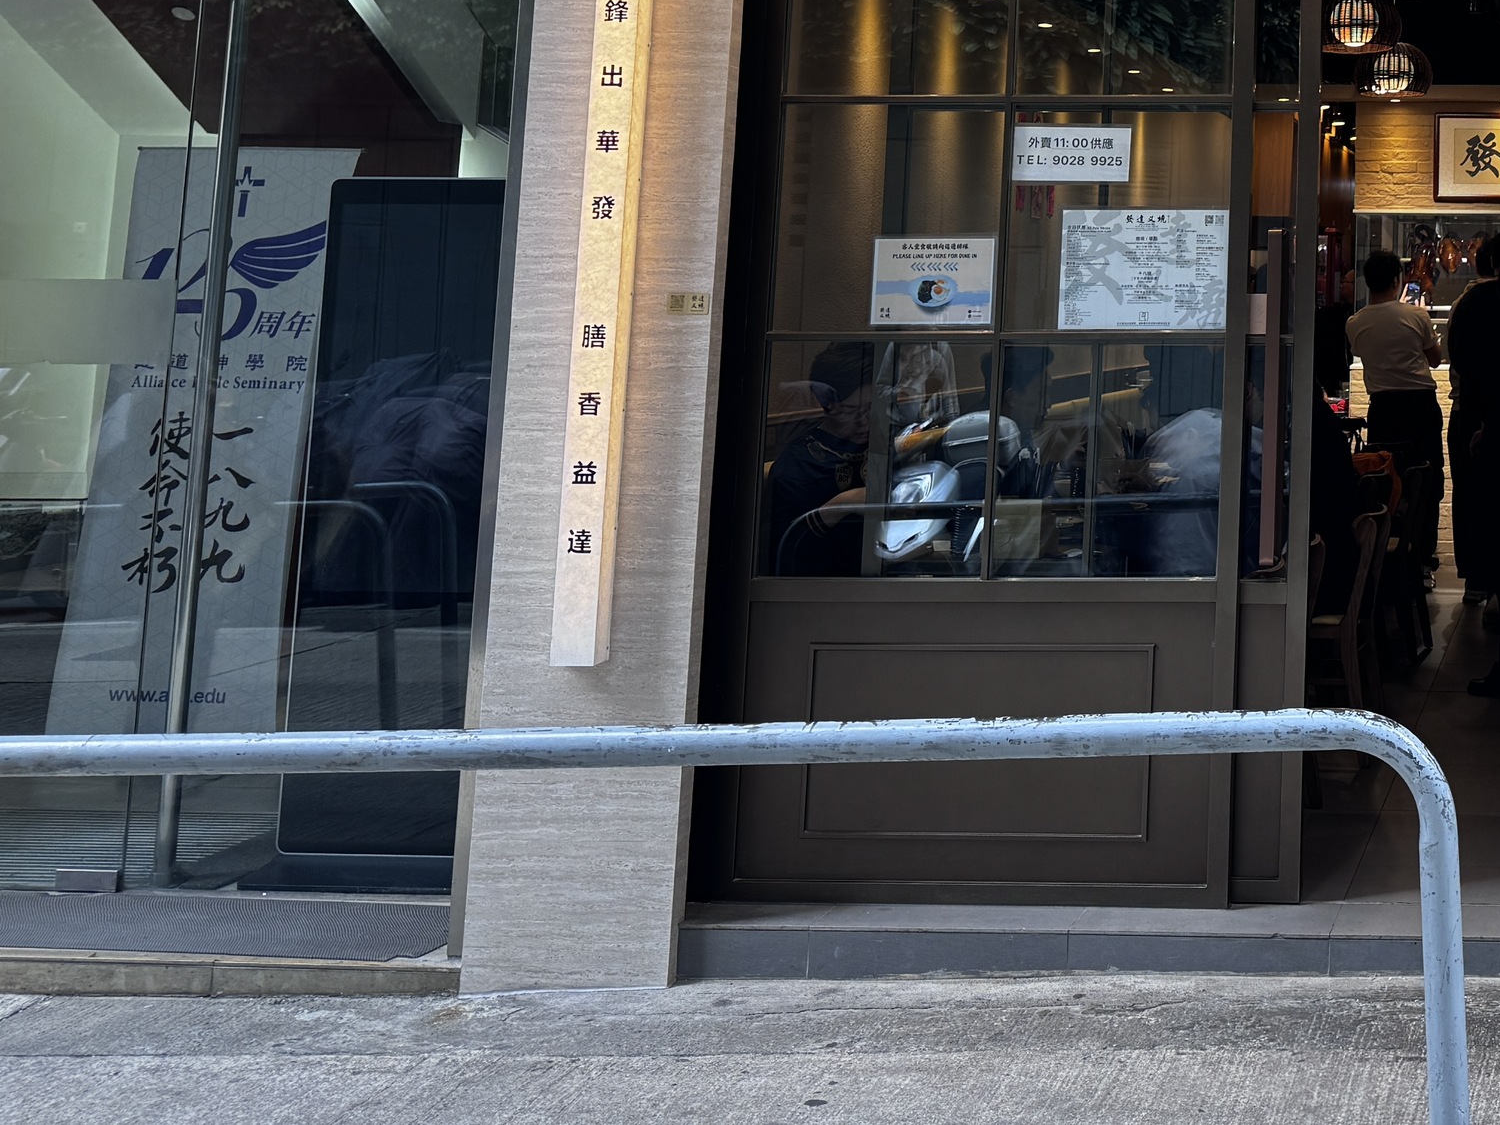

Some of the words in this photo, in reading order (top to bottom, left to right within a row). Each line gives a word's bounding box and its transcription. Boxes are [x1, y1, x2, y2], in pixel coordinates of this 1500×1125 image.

[1052, 155, 1085, 166] 9028
[1090, 156, 1123, 166] 9925
[131, 376, 187, 388] Alliace
[233, 376, 305, 393] Seminary
